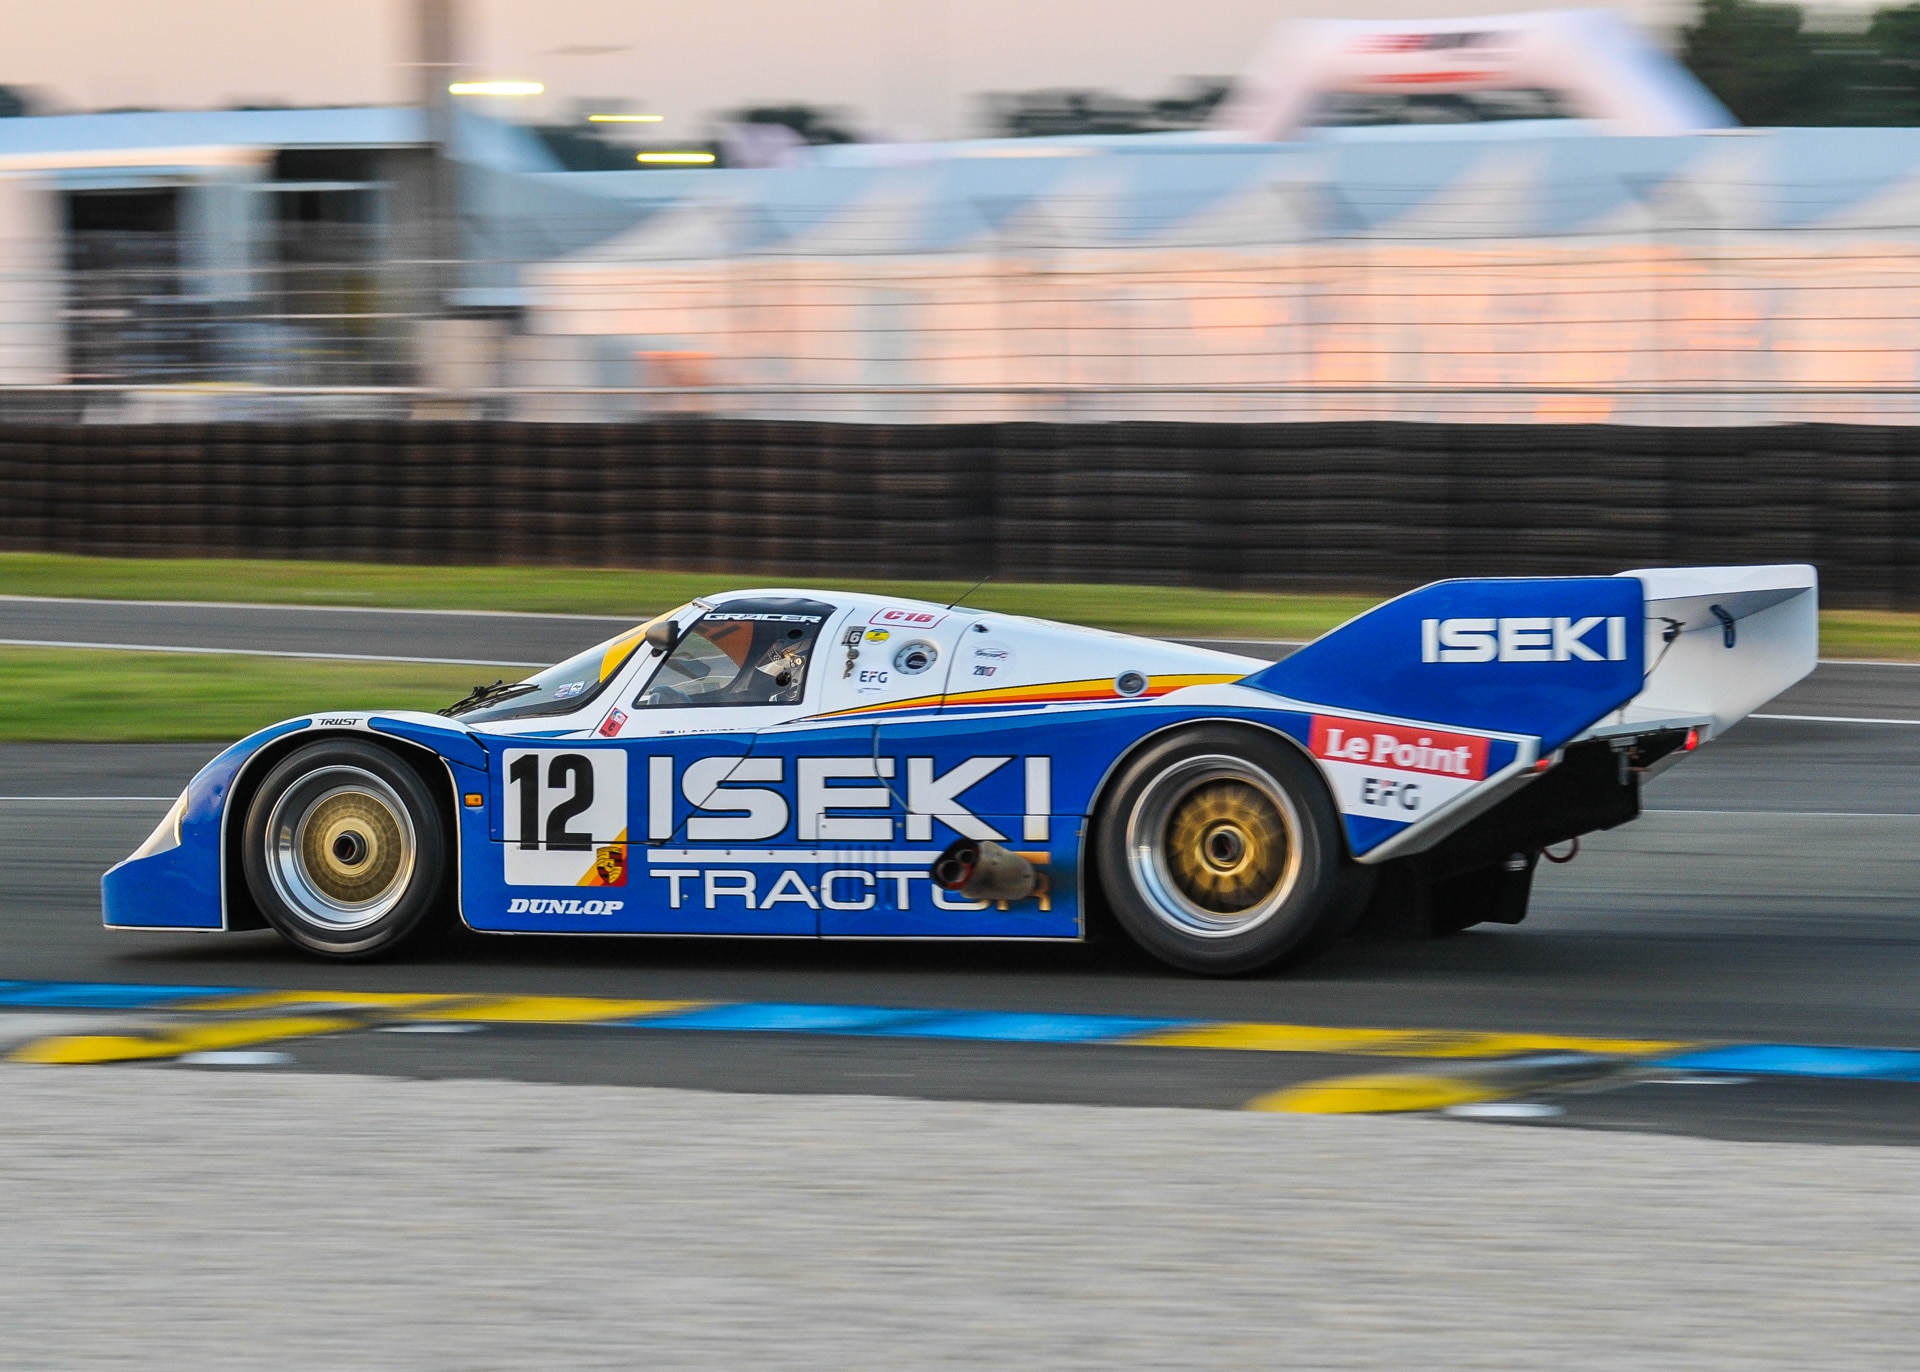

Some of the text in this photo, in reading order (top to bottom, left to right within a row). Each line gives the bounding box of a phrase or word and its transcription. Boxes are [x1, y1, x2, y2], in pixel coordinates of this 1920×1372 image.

[1421, 616, 1627, 663] ISEKI
[859, 670, 888, 683] EFG
[318, 718, 364, 726] TRUST
[1369, 733, 1472, 775] Point
[509, 754, 594, 851] 12
[647, 755, 1051, 841] ISEKI
[1361, 777, 1421, 811] EFG
[507, 898, 624, 915] DUNLOP
